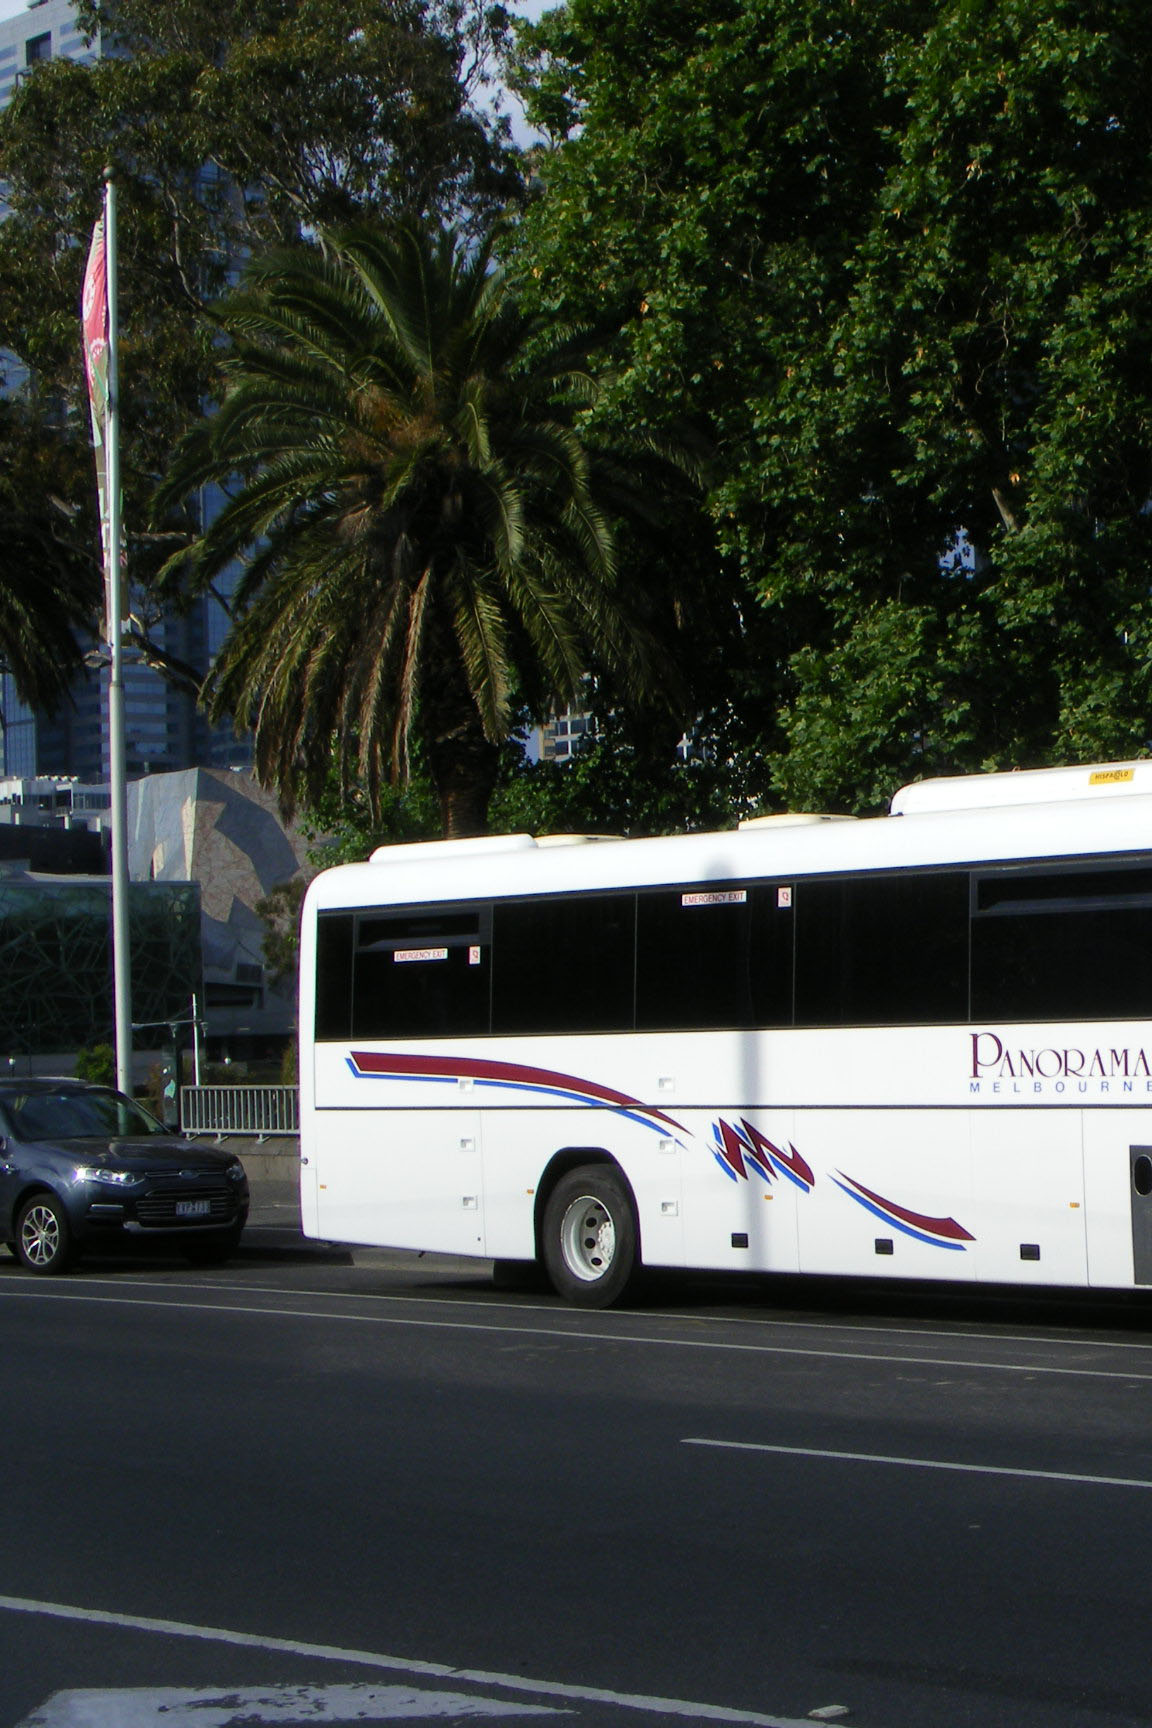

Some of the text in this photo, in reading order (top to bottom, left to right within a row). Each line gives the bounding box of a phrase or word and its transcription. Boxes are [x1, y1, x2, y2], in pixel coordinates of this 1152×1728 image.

[684, 891, 744, 904] EMERGENCY EXIT
[396, 949, 446, 961] EMERGENCY EXIT
[969, 1032, 1152, 1078] PANORAMA
